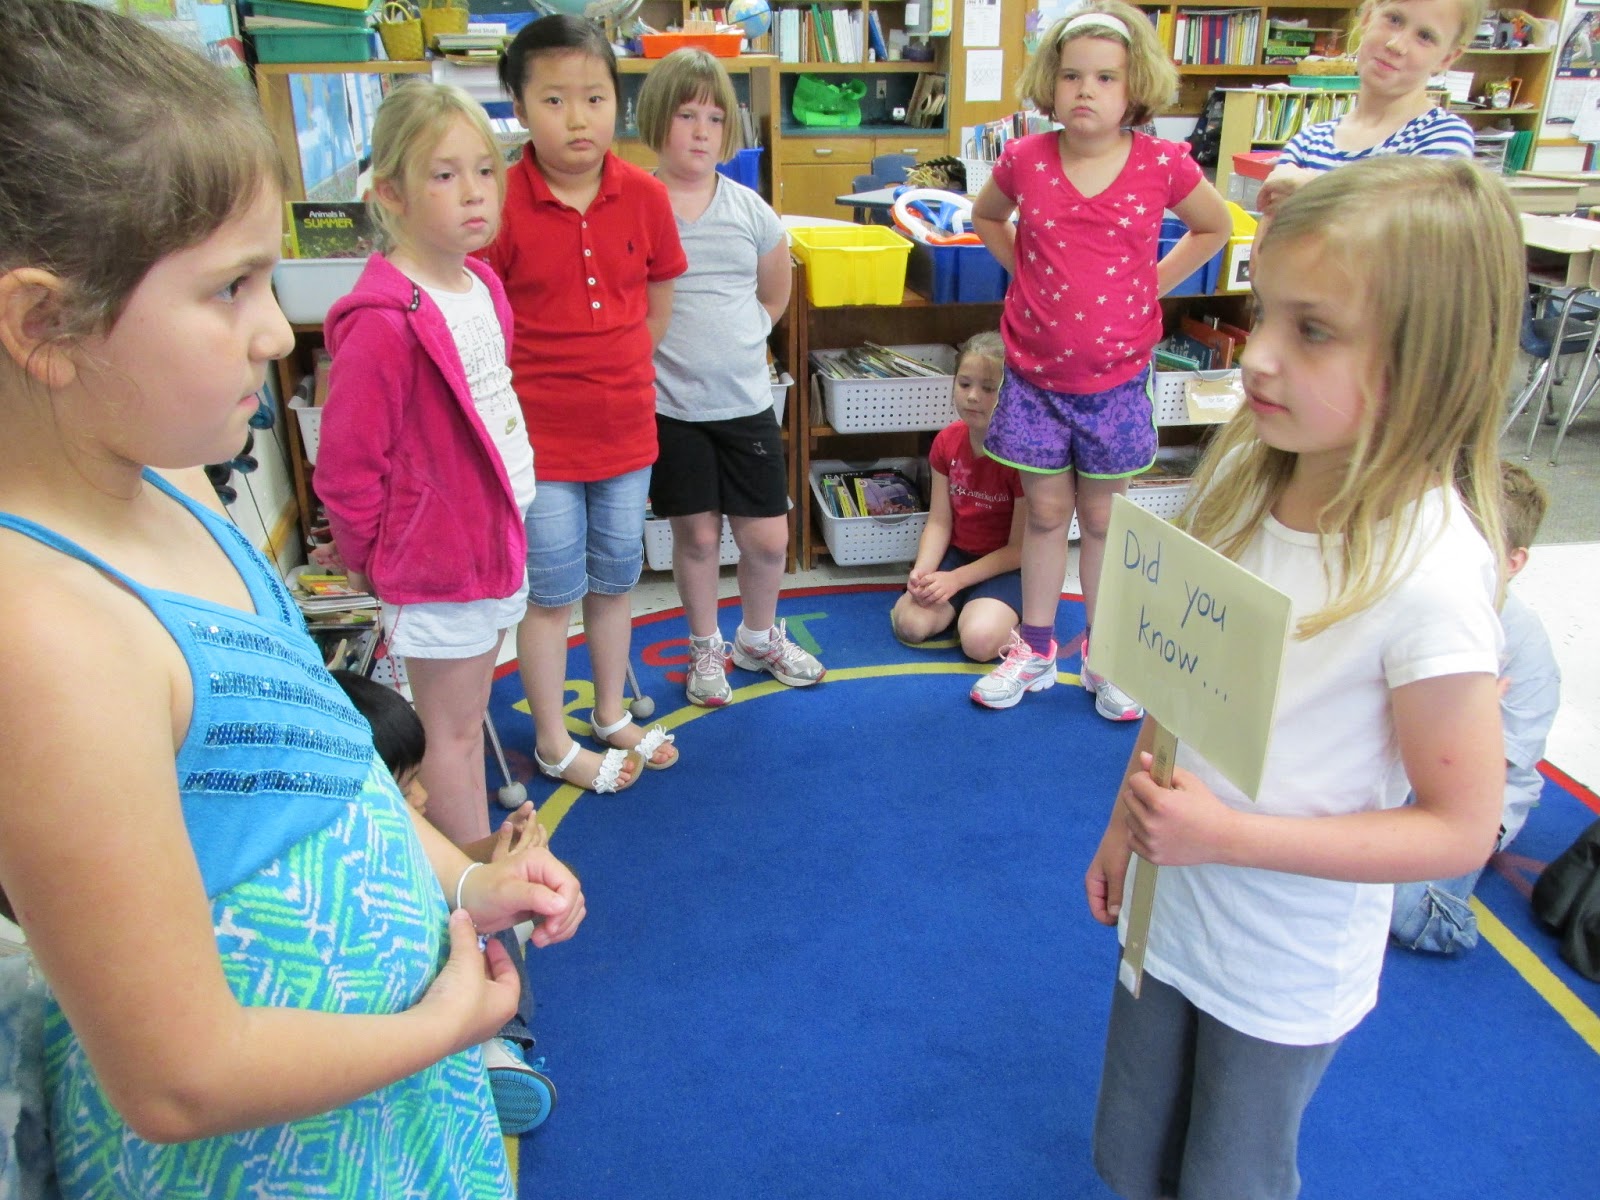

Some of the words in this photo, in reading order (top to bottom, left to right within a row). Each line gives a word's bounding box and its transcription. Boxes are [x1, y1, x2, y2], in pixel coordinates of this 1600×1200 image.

[309, 210, 337, 218] Animals
[303, 218, 353, 229] SUMMER
[1123, 529, 1161, 584] Did
[1180, 580, 1227, 632] you
